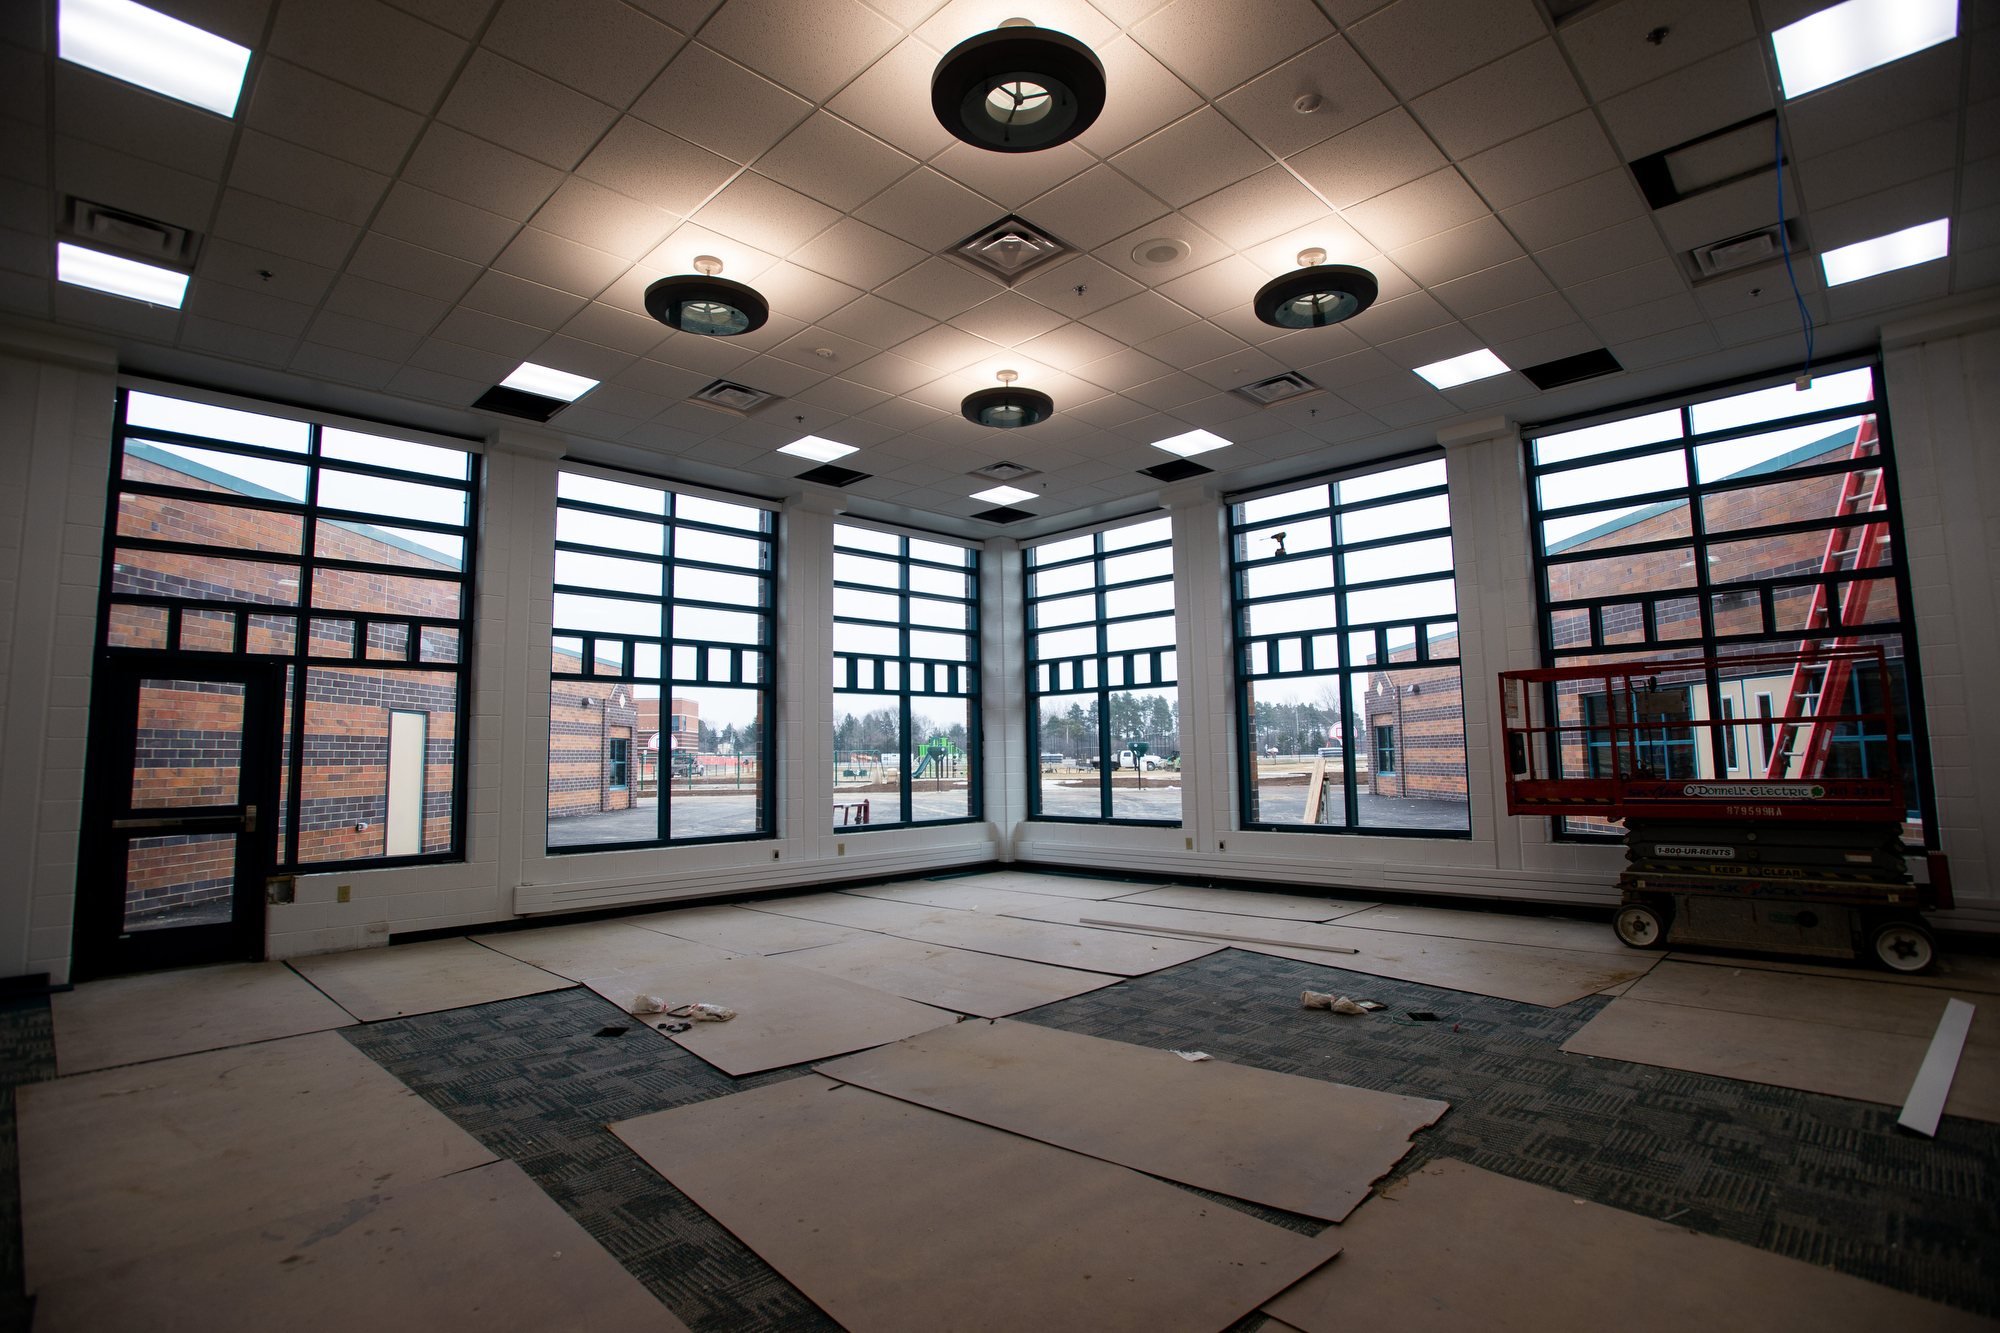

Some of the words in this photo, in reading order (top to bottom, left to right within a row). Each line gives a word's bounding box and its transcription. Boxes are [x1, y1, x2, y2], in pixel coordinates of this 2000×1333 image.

[1627, 785, 1692, 797] SKYJAC
[1657, 847, 1731, 856] 1-800-UR-RENTS
[1714, 866, 1743, 874] KEEP
[1763, 868, 1800, 877] CLEAR
